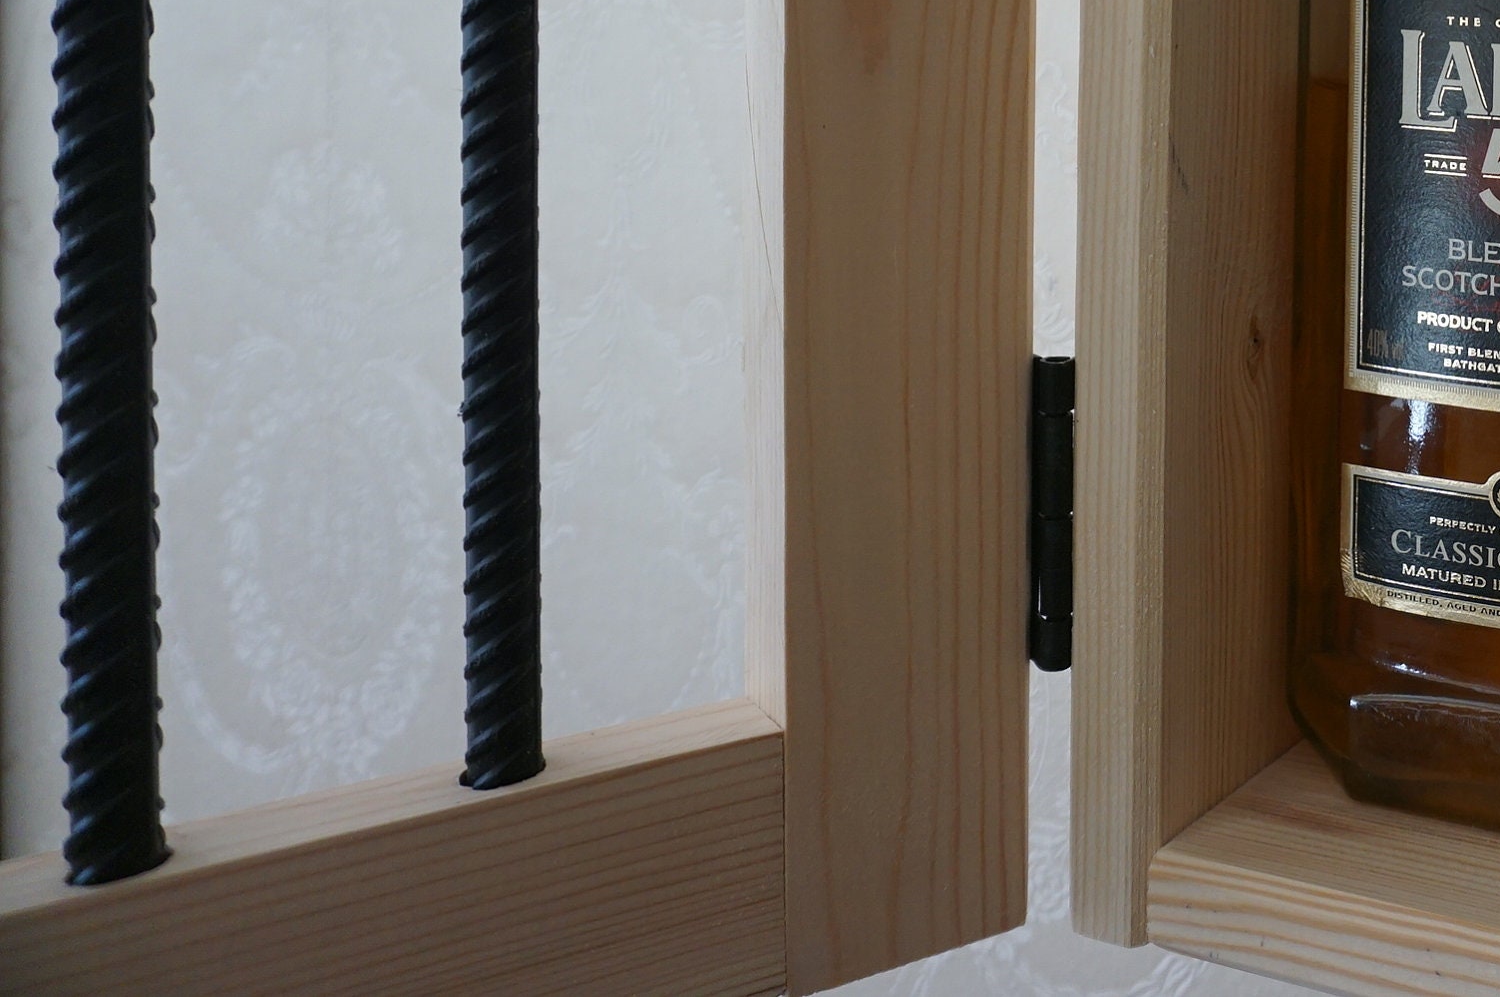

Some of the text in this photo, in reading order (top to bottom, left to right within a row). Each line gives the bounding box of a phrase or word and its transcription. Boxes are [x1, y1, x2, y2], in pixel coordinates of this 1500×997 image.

[1447, 16, 1481, 27] THE
[1424, 159, 1467, 171] TRADE
[1417, 311, 1493, 333] PRODUCT
[1428, 342, 1463, 357] FIRST
[1429, 516, 1497, 535] PERFECTLY
[1401, 563, 1487, 589] MATURED
[1446, 601, 1477, 615] AGED
